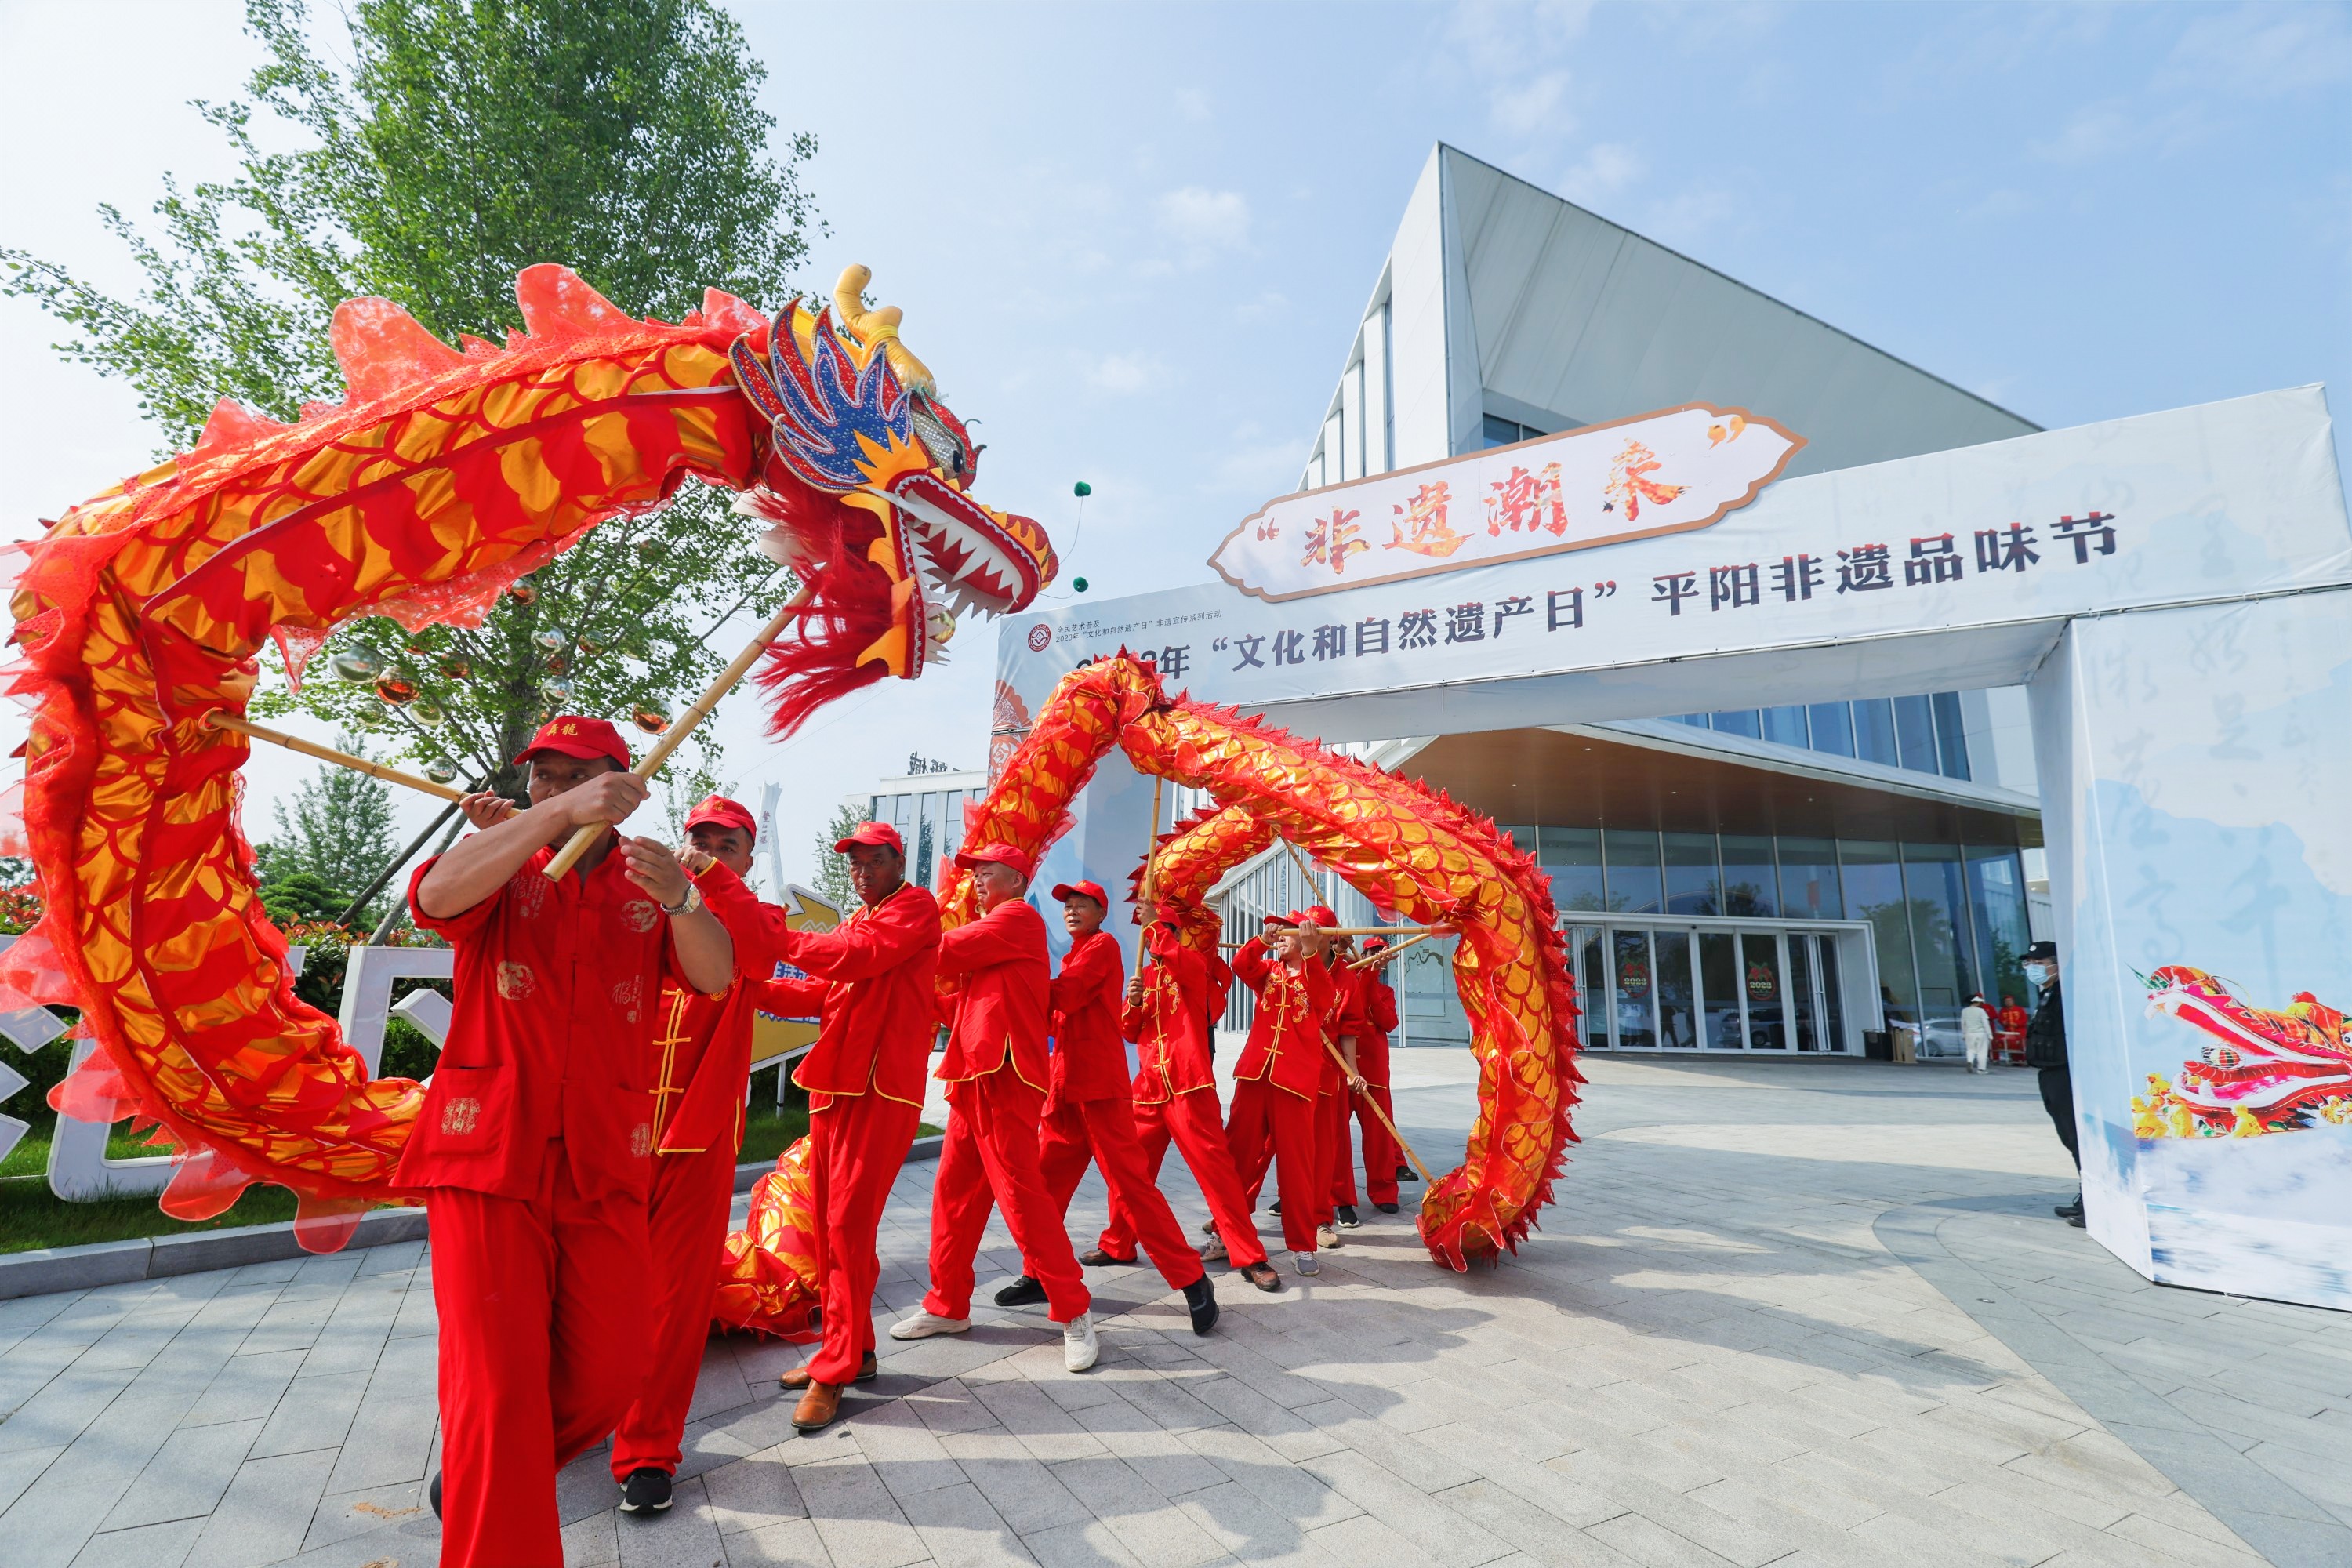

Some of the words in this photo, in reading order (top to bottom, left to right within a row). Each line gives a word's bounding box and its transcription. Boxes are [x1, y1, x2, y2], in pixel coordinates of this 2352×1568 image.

[1057, 619, 1100, 634] 全民艺术普及
